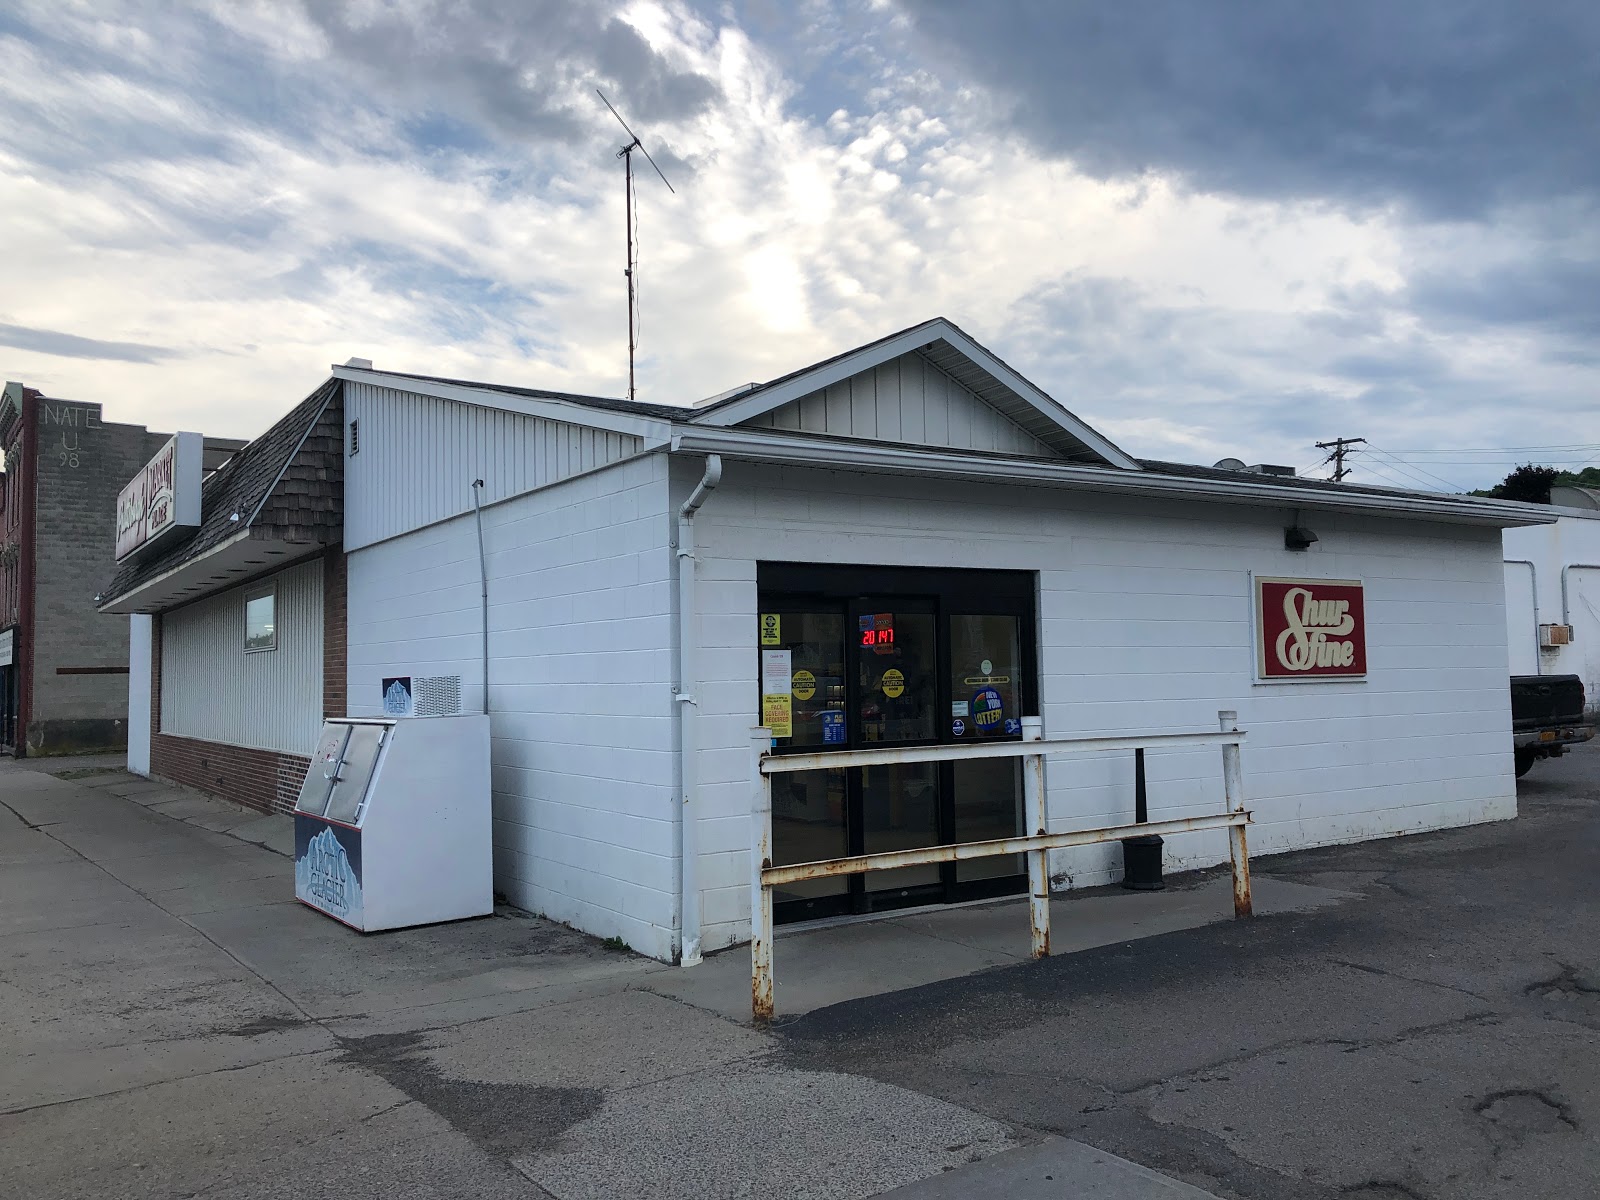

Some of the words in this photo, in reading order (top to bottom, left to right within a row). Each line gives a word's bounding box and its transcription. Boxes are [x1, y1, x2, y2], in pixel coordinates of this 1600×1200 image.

[44, 403, 102, 429] NATE
[62, 431, 82, 450] U.
[59, 452, 80, 468] 98
[1282, 587, 1354, 635] Shur
[863, 630, 875, 645] 20
[878, 628, 894, 643] 147
[1275, 630, 1354, 671] Fine
[987, 699, 1001, 709] YORK
[974, 708, 1002, 725] LOTTERY
[310, 848, 347, 883] ARCTIC
[310, 872, 347, 910] GLACIER
